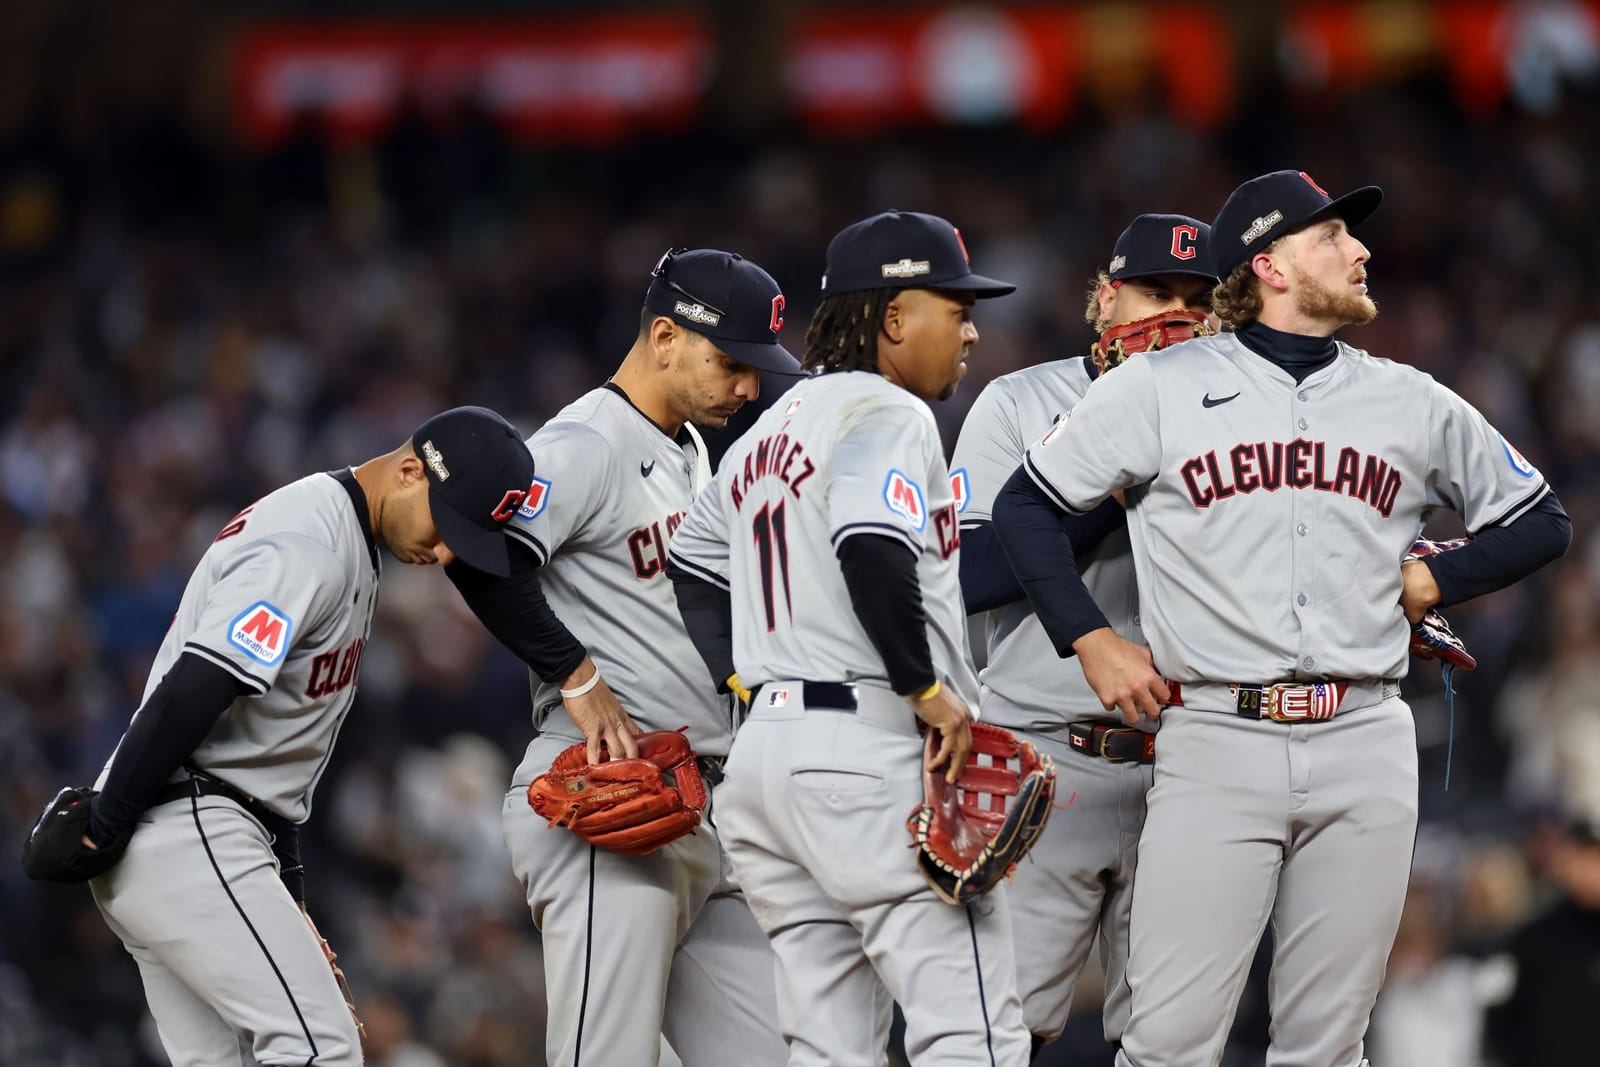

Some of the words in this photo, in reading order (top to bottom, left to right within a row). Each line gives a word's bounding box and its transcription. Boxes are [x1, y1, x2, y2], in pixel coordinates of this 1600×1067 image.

[1171, 224, 1199, 260] C
[675, 303, 718, 325] POSTSEASON
[770, 294, 785, 334] C
[731, 419, 815, 514] RAMÍREZ
[1180, 437, 1402, 518] CLEVELAND
[491, 490, 526, 521] C
[752, 496, 793, 633] 11
[233, 631, 275, 659] Marathon
[241, 609, 283, 651] M
[1241, 690, 1258, 709] 28
